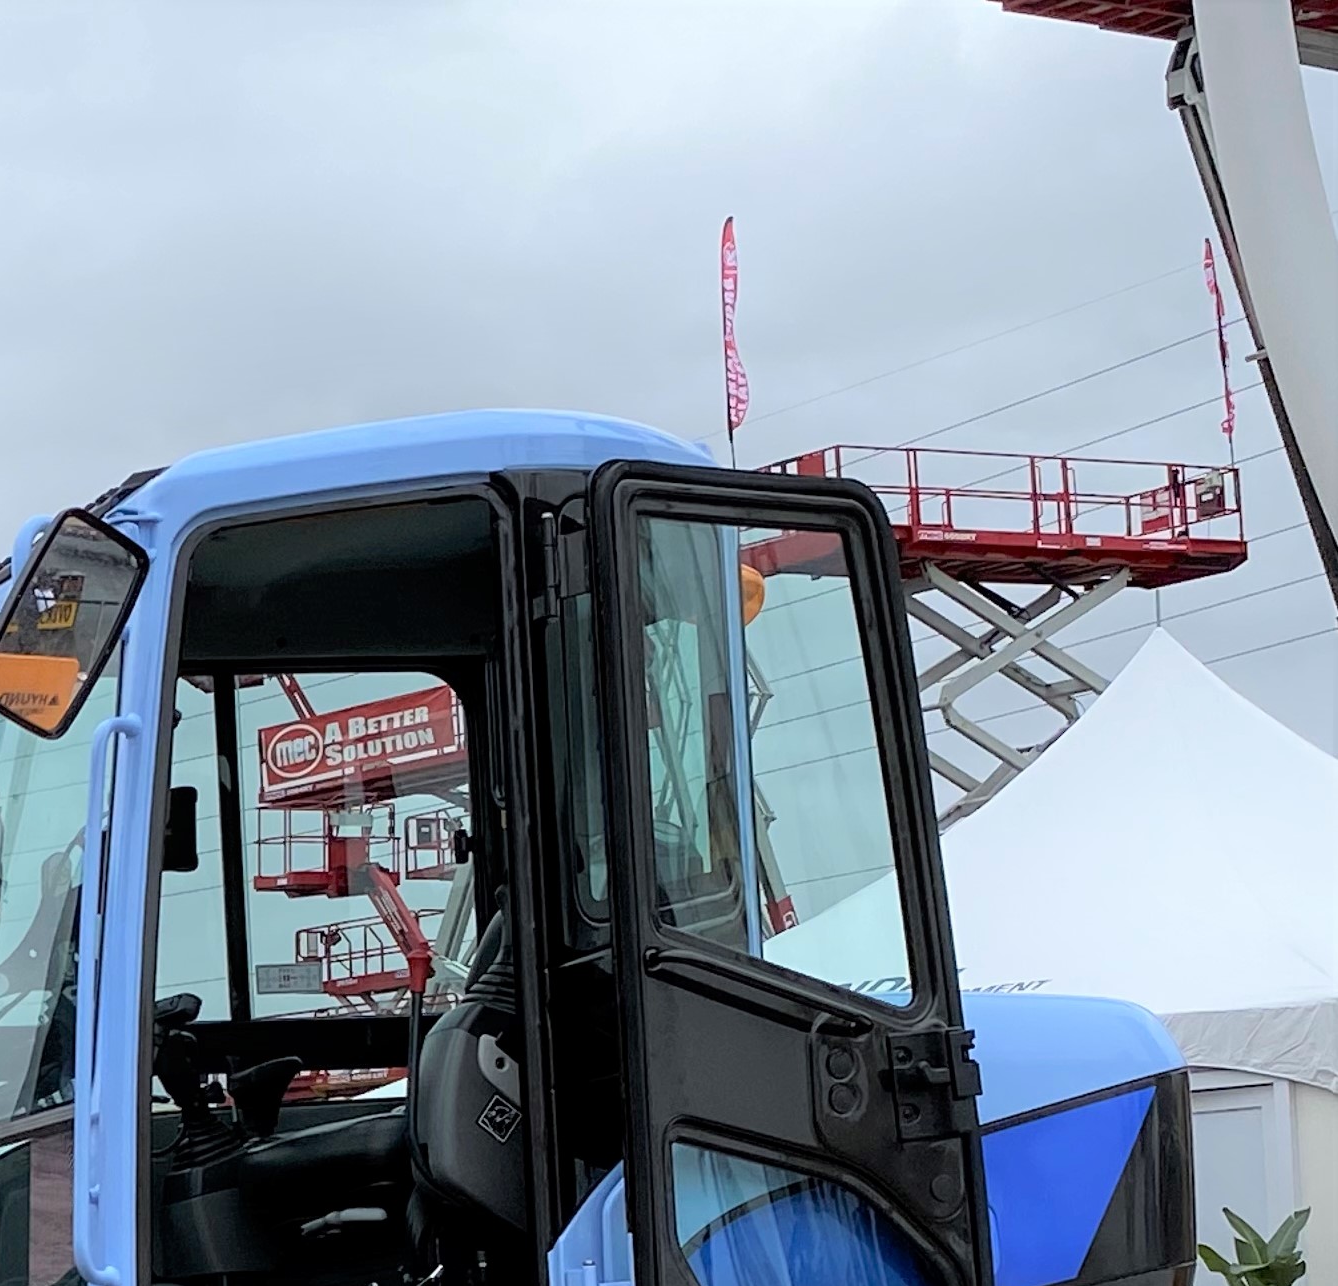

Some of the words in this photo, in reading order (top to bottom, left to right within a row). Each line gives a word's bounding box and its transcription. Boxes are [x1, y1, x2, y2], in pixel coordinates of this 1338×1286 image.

[325, 721, 343, 743] A
[348, 705, 429, 740] BETTER
[325, 726, 436, 767] SOLUTION
